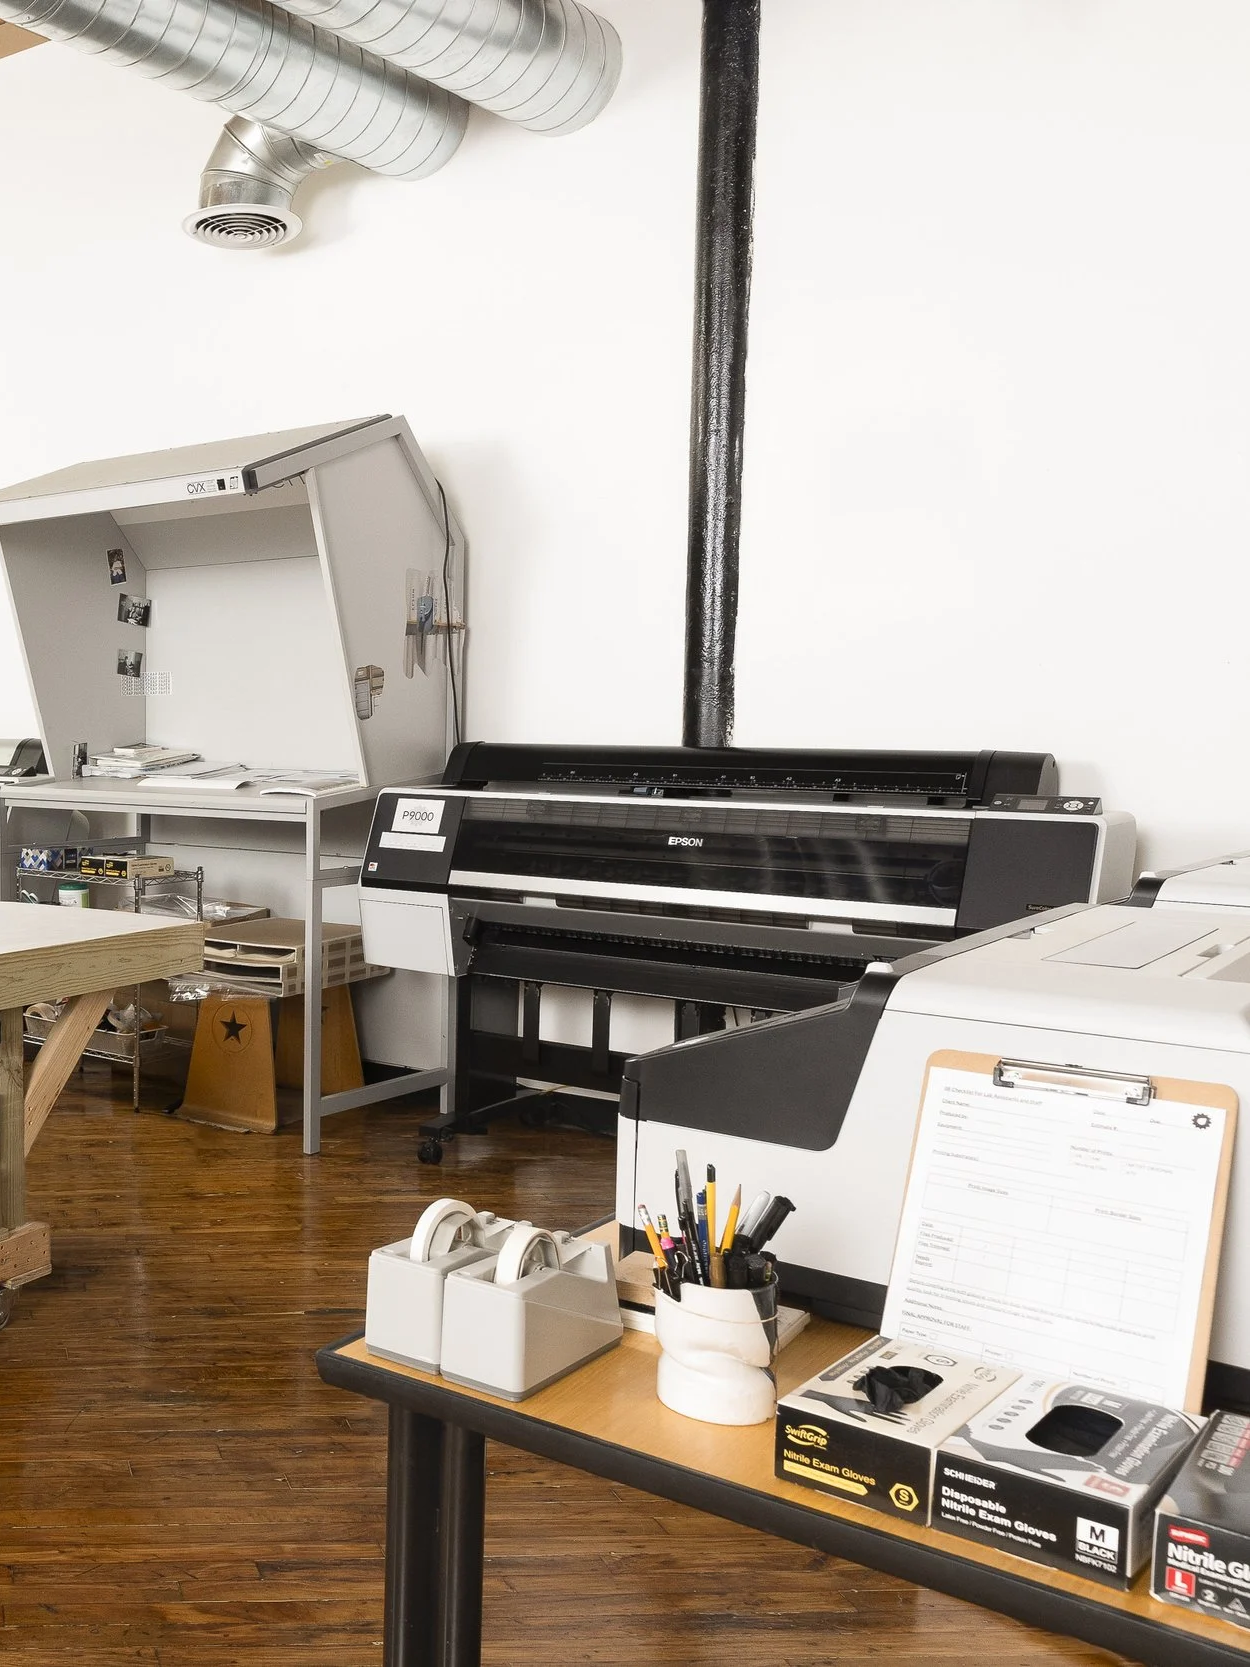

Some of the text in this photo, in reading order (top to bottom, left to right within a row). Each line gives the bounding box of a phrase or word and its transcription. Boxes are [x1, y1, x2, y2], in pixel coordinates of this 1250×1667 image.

[186, 482, 206, 494] CVX
[402, 810, 435, 821] P9000
[668, 836, 704, 847] EPSON
[784, 1424, 828, 1446] SwiftGrip
[907, 1416, 934, 1434] Gloves
[1130, 1426, 1168, 1460] Examination
[784, 1448, 876, 1486] Nitrile Exam Gloves
[1114, 1456, 1142, 1476] Gloves
[943, 1467, 996, 1490] SCHNEIDER
[899, 1488, 910, 1502] S
[941, 1486, 1007, 1514] Disposable
[941, 1498, 1057, 1542] Nitrile Exam Gloves
[956, 1516, 969, 1525] Free
[972, 1521, 992, 1532] Powder
[993, 1526, 1005, 1536] Free
[1028, 1538, 1041, 1548] Free
[1090, 1525, 1105, 1543] M
[1078, 1540, 1115, 1560] BLACK
[1167, 1542, 1227, 1574] Nitrile
[1174, 1571, 1188, 1589] L
